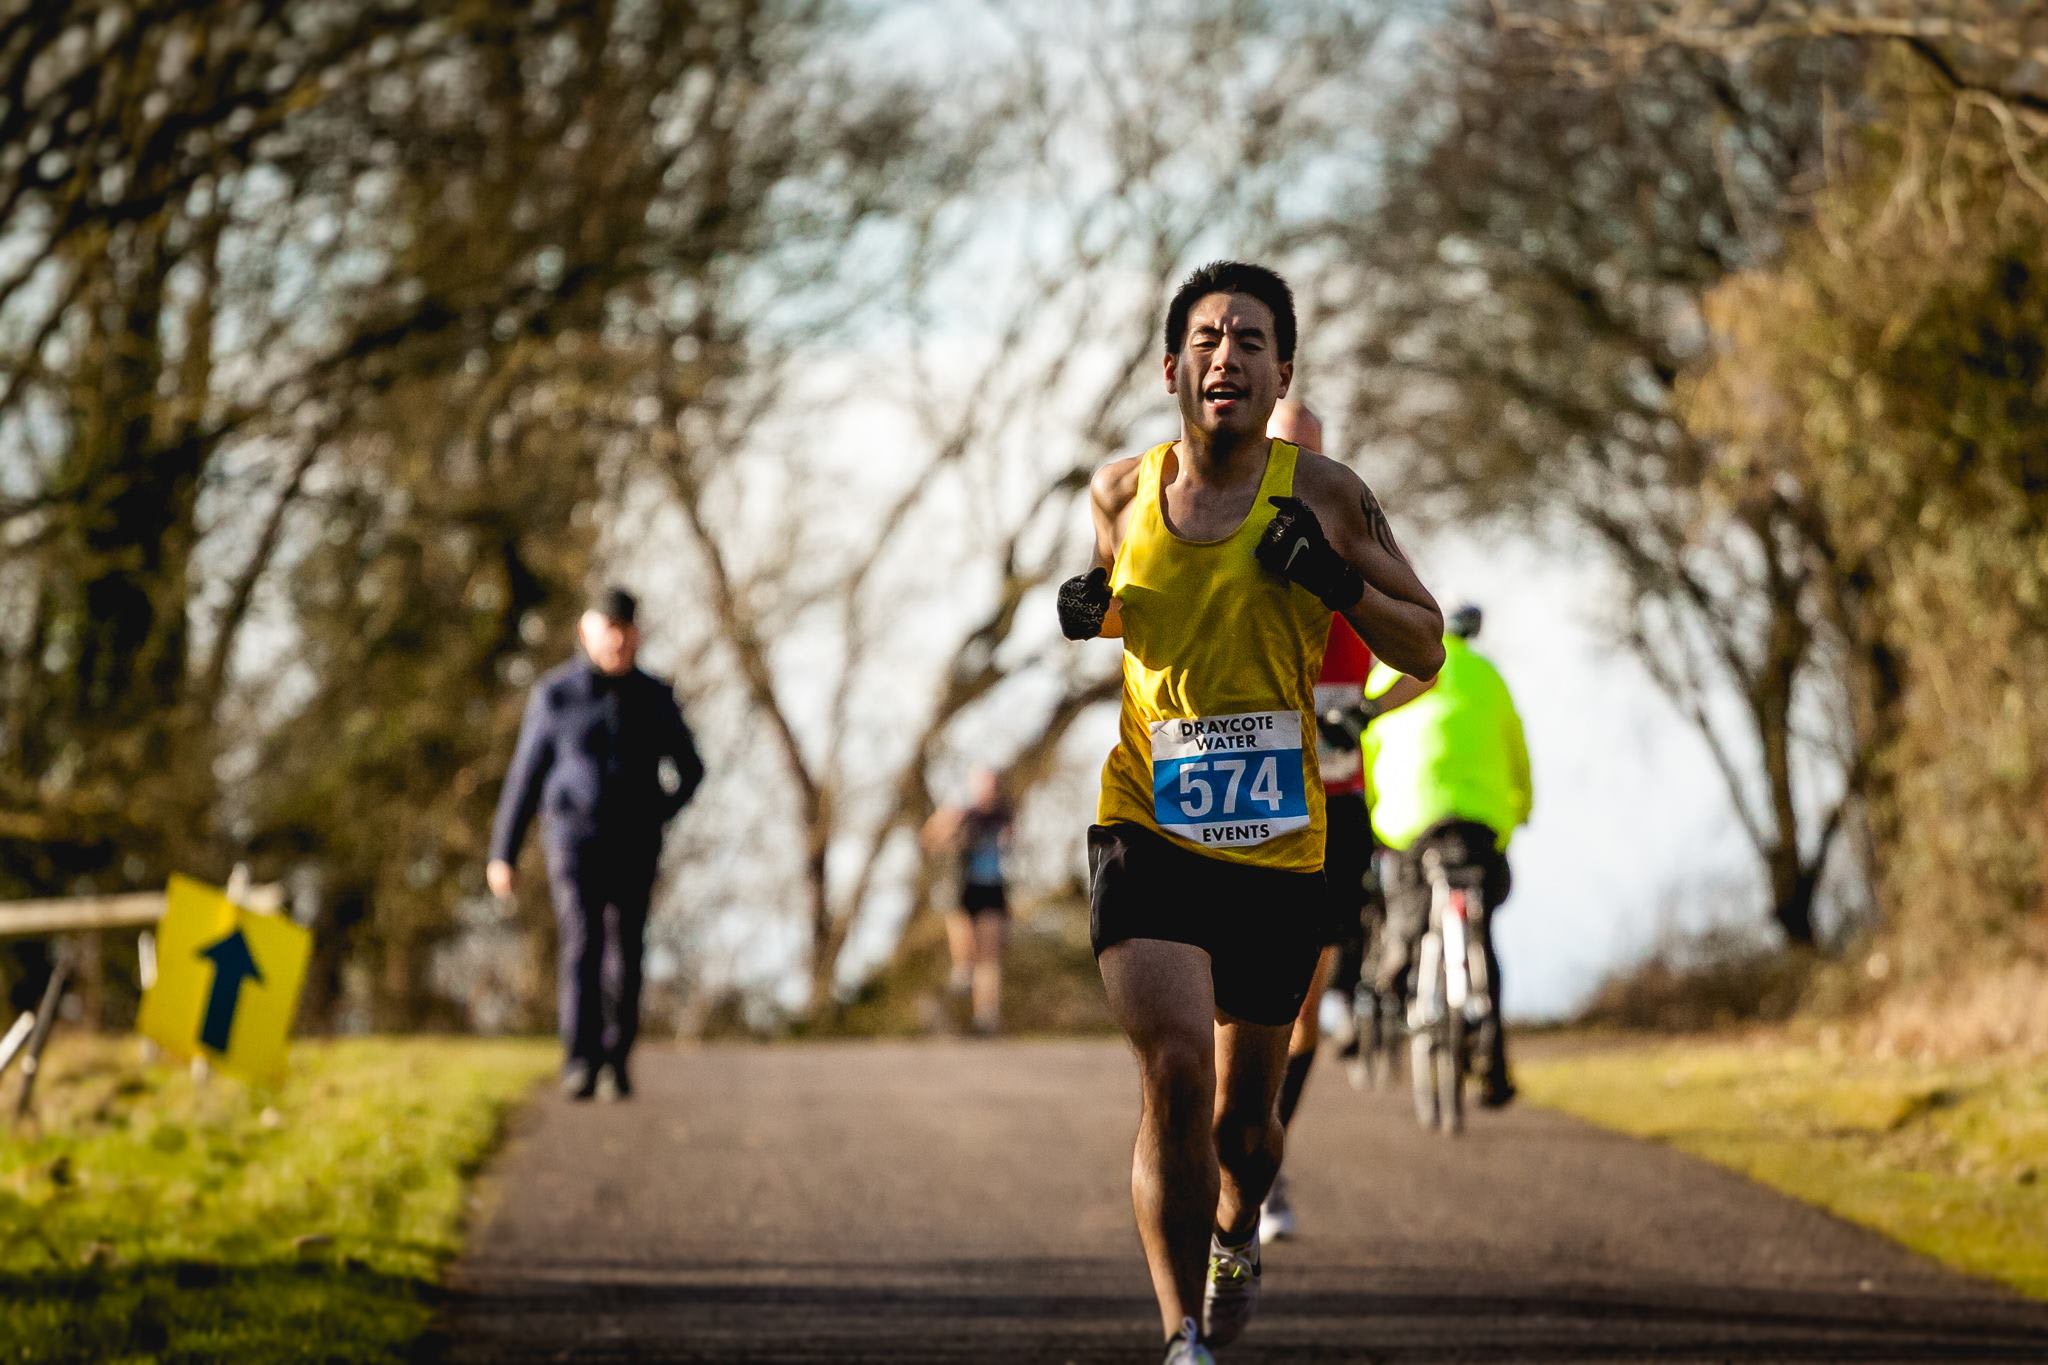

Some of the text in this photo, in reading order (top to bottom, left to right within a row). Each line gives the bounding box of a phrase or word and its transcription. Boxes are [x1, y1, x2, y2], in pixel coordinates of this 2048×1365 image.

[1181, 716, 1273, 737] DRAYCOTE
[1196, 735, 1257, 750] WATER
[1180, 757, 1283, 818] 574
[1203, 824, 1270, 842] EVENTS
